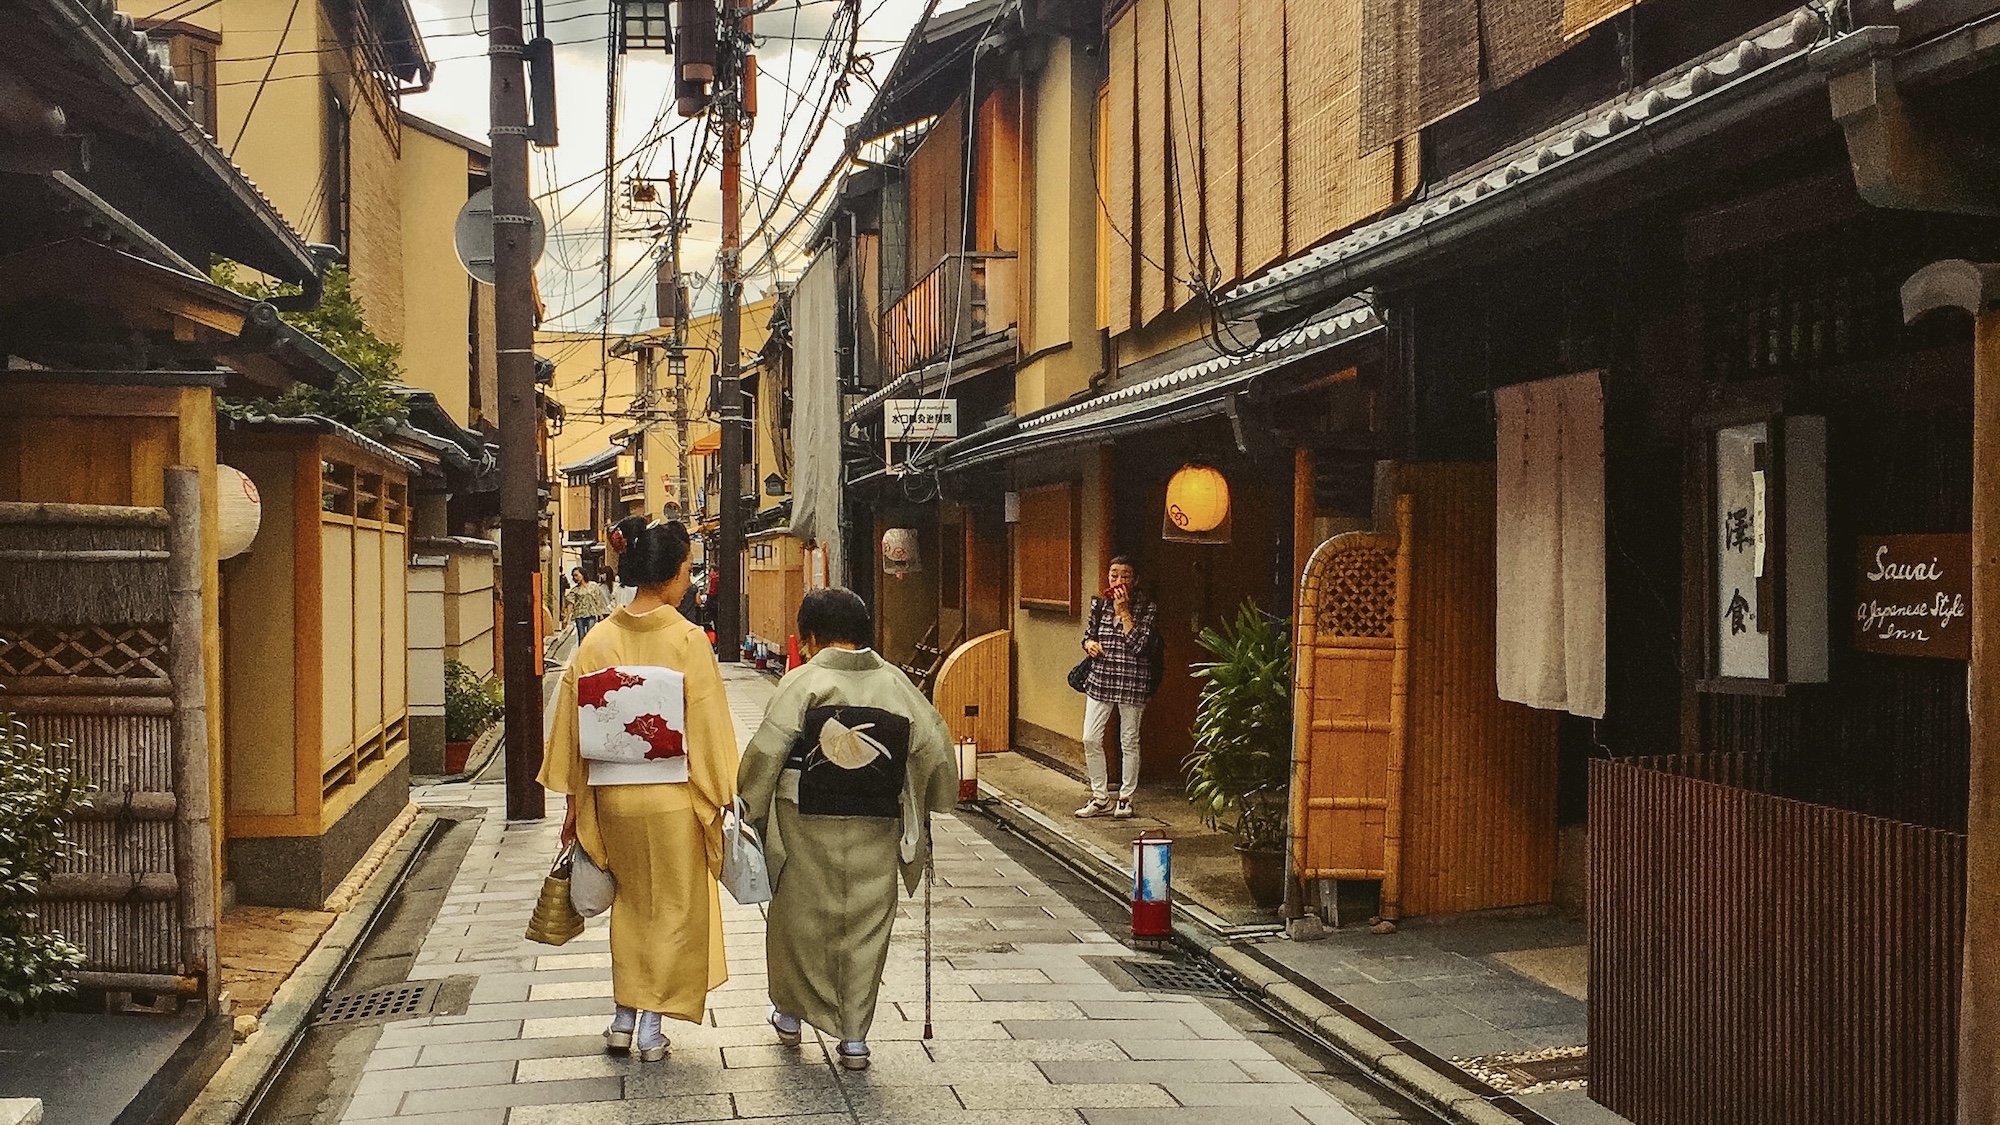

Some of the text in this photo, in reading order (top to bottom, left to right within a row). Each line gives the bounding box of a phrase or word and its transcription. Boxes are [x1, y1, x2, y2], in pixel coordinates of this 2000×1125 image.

[1863, 600, 1928, 632] Japanese
[1930, 591, 1964, 628] Style
[1879, 623, 1930, 641] Inn
